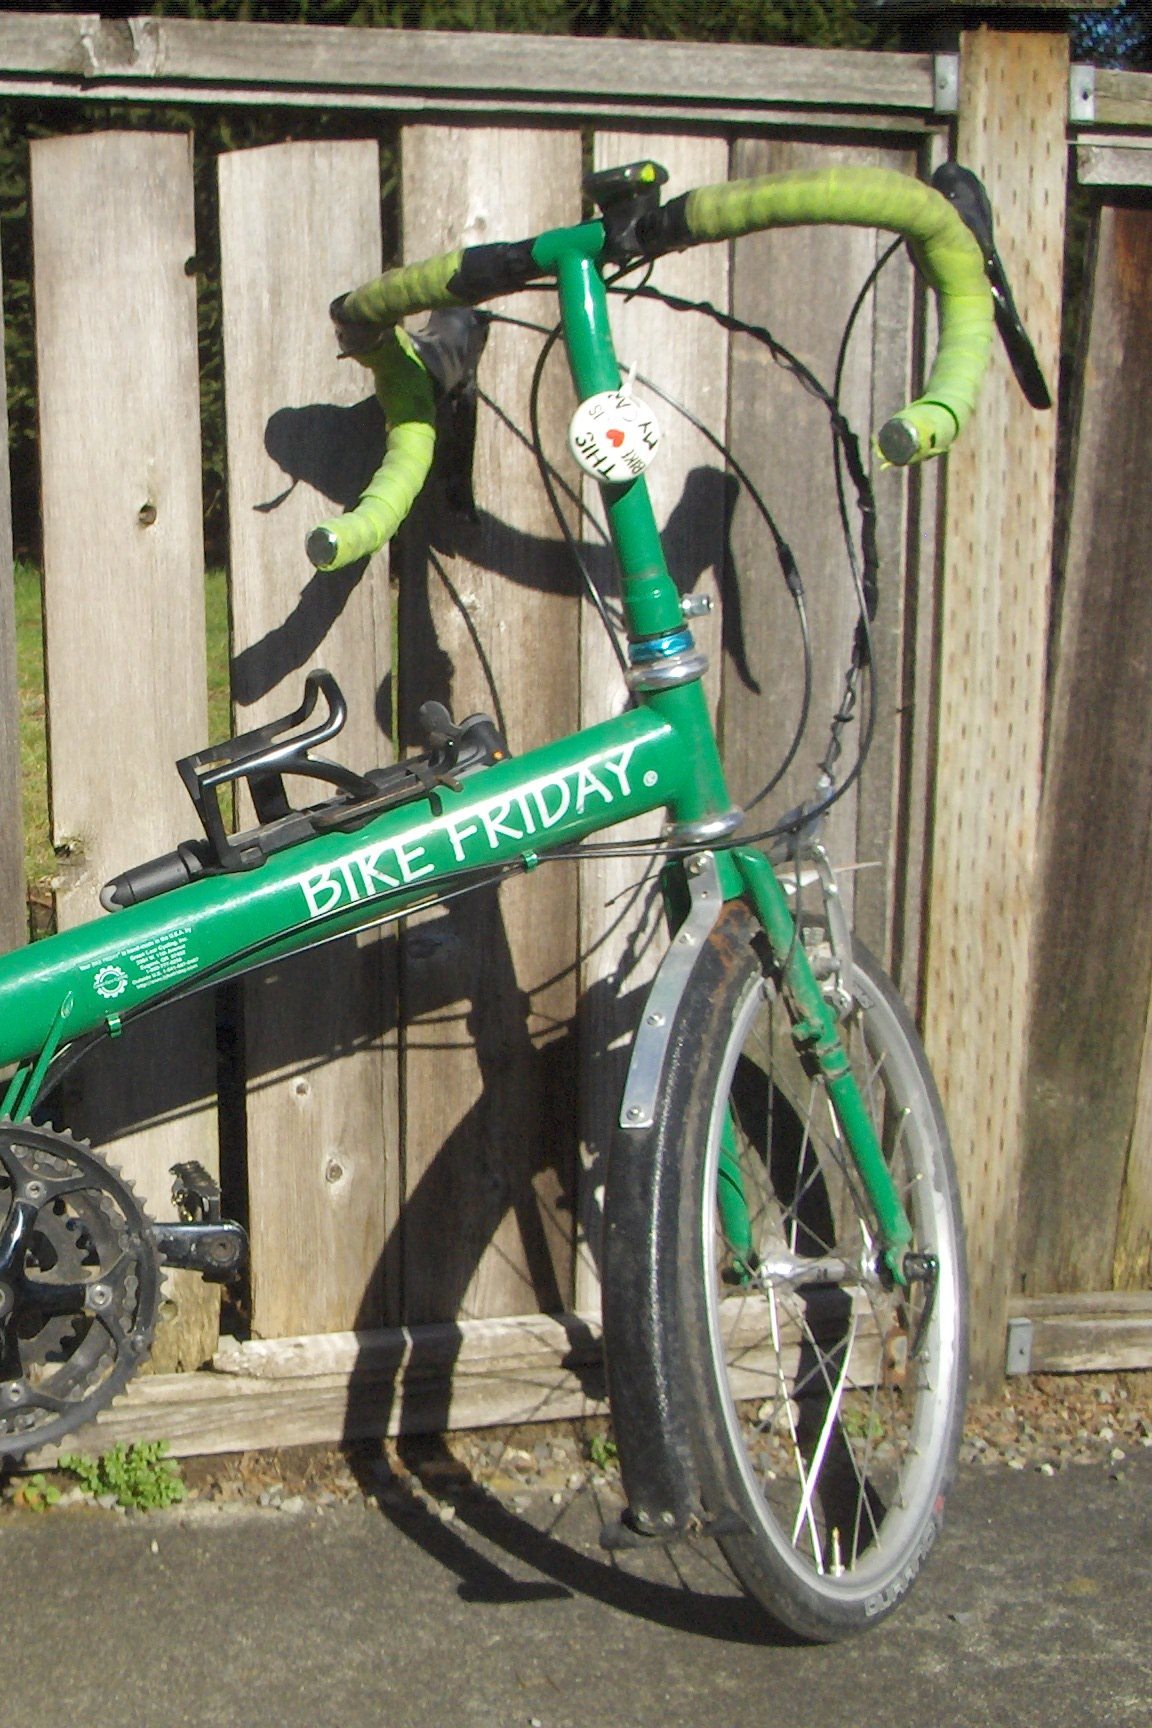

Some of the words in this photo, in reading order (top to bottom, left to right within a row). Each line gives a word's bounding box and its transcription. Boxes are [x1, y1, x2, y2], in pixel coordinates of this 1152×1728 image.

[575, 431, 615, 481] THIS
[638, 421, 658, 451] MY
[298, 832, 435, 918] BIKE
[447, 745, 639, 862] FRIDAY
